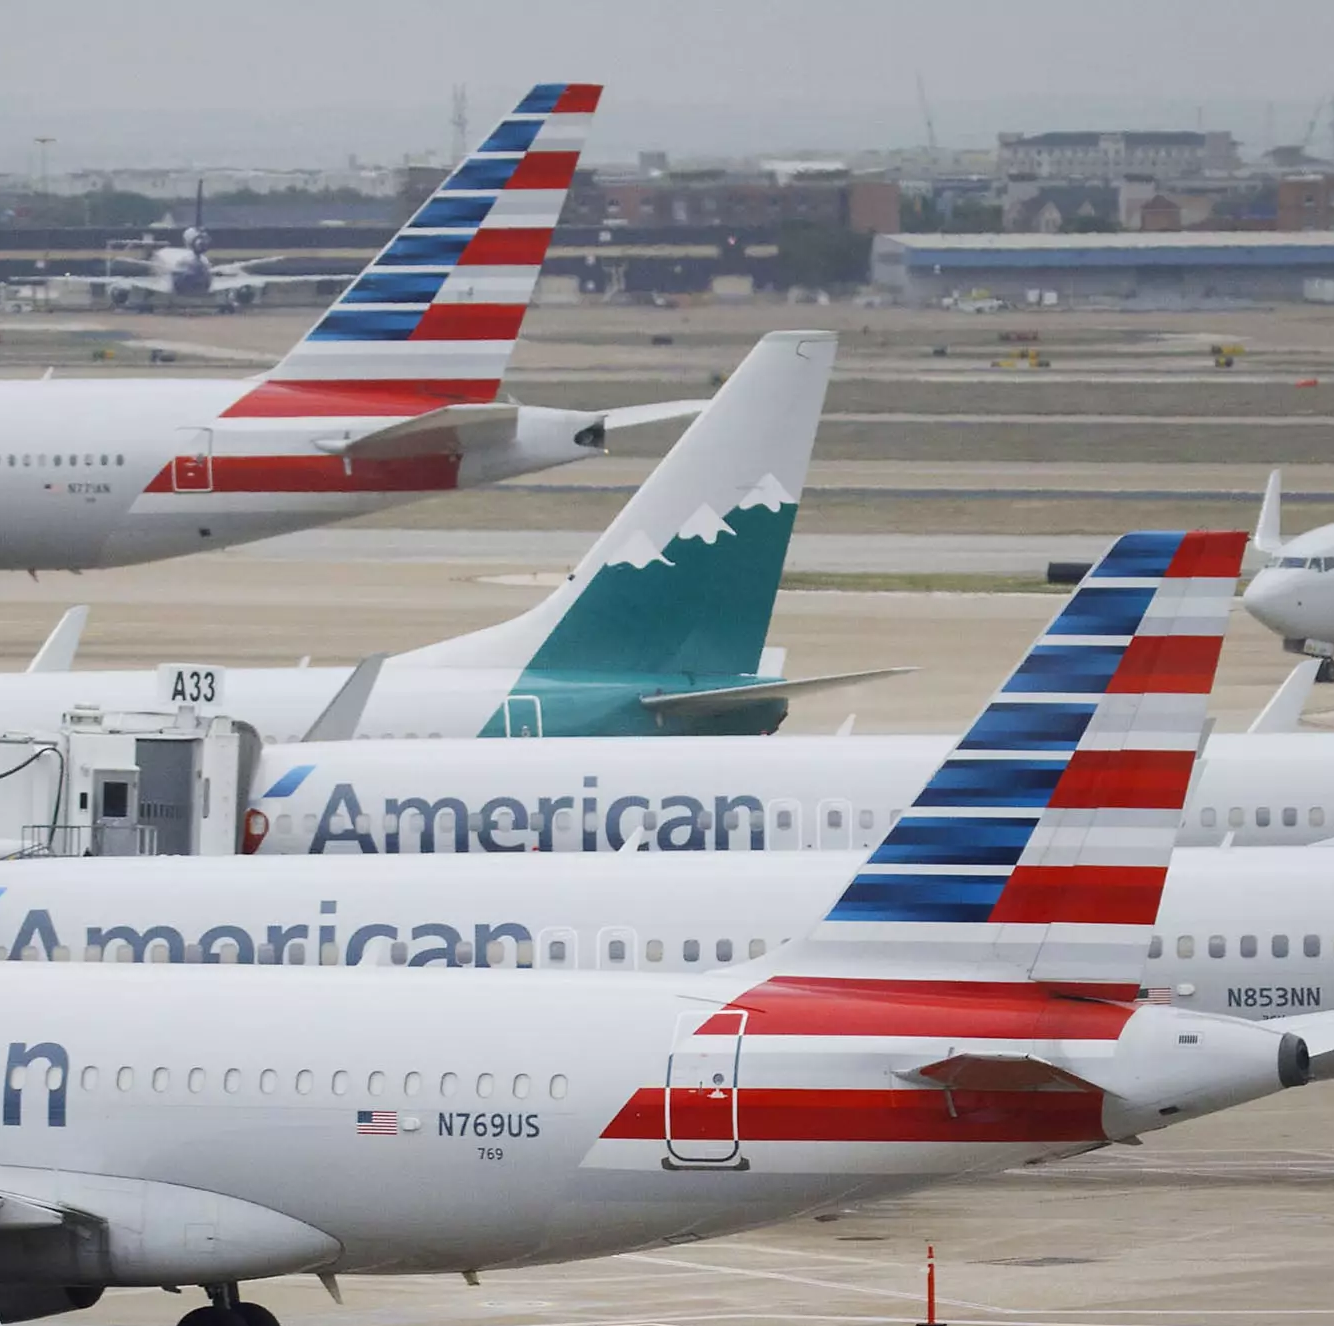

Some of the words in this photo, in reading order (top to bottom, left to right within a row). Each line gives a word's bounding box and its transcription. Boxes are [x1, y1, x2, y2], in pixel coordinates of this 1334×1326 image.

[171, 671, 215, 702] A33
[308, 775, 765, 854] American
[1228, 987, 1321, 1007] N853NN
[438, 1112, 540, 1138] N769US
[477, 1147, 503, 1160] 769
